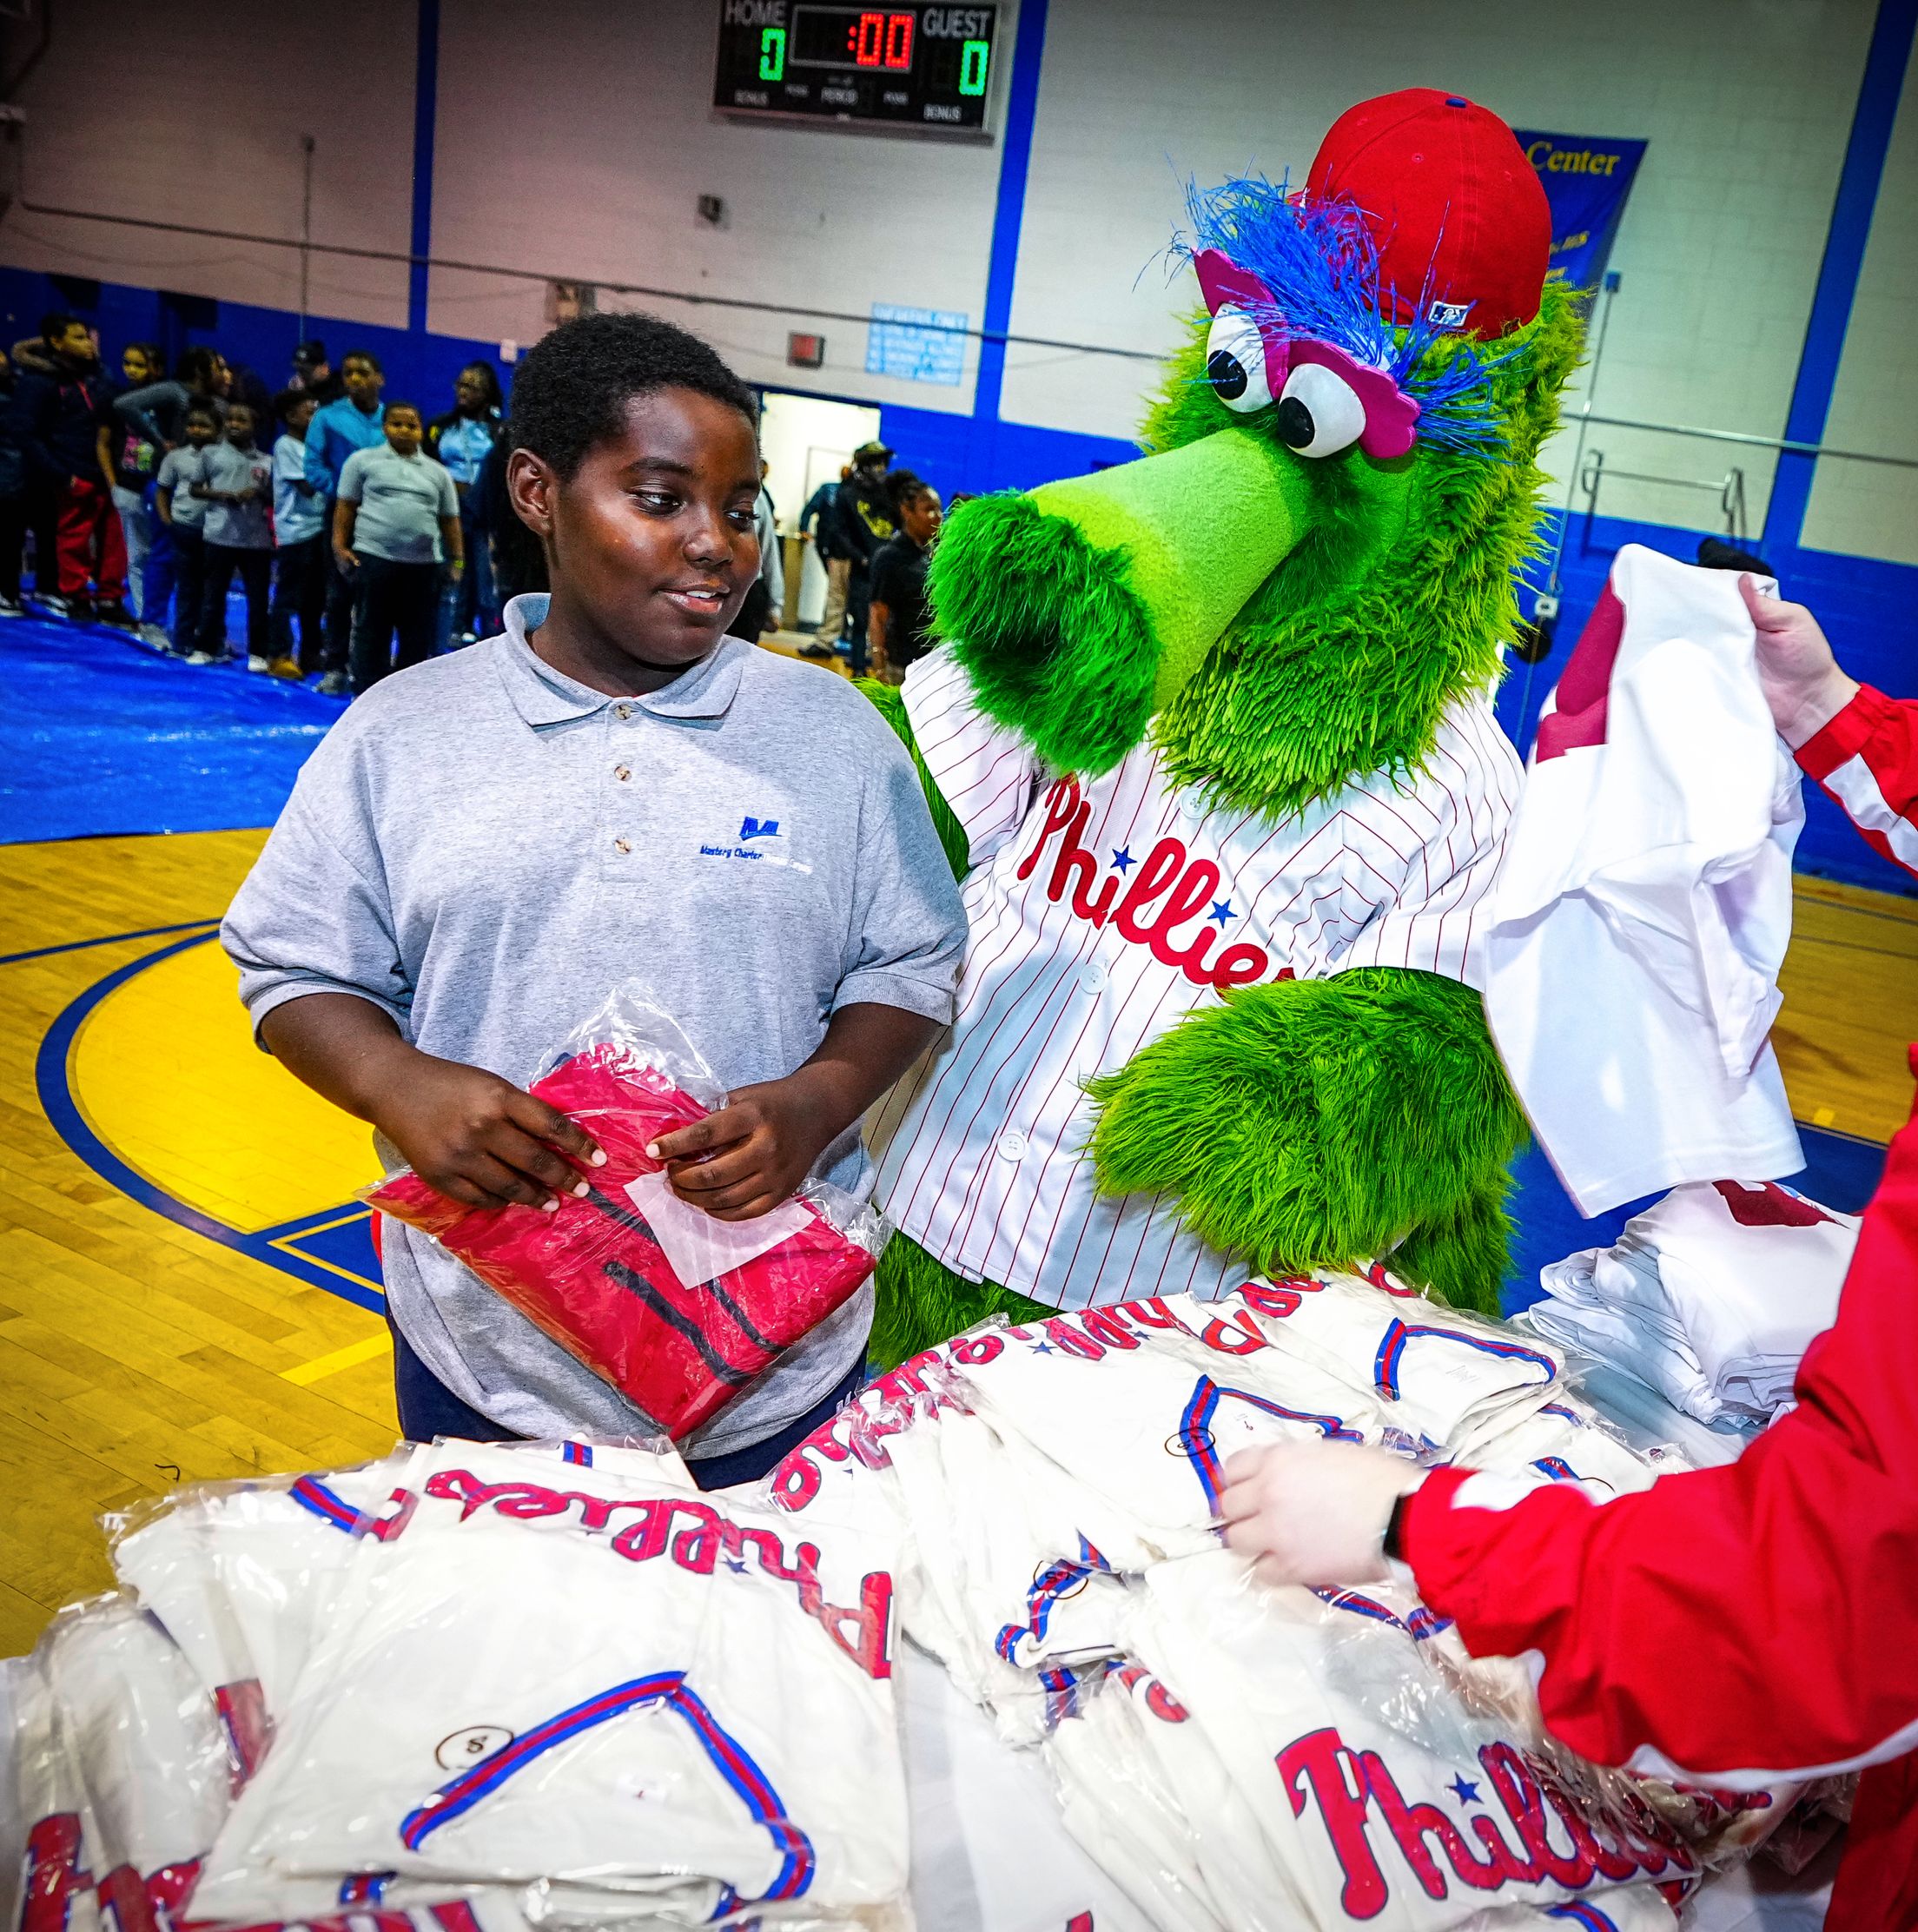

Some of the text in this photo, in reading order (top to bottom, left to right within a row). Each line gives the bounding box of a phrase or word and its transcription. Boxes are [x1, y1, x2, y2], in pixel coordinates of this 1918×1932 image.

[724, 0, 786, 25] HOME
[923, 8, 992, 37] GUEST
[959, 40, 989, 96] 0
[1526, 141, 1620, 176] Center
[734, 848, 764, 860] Charter
[1017, 771, 1296, 999] Phillie
